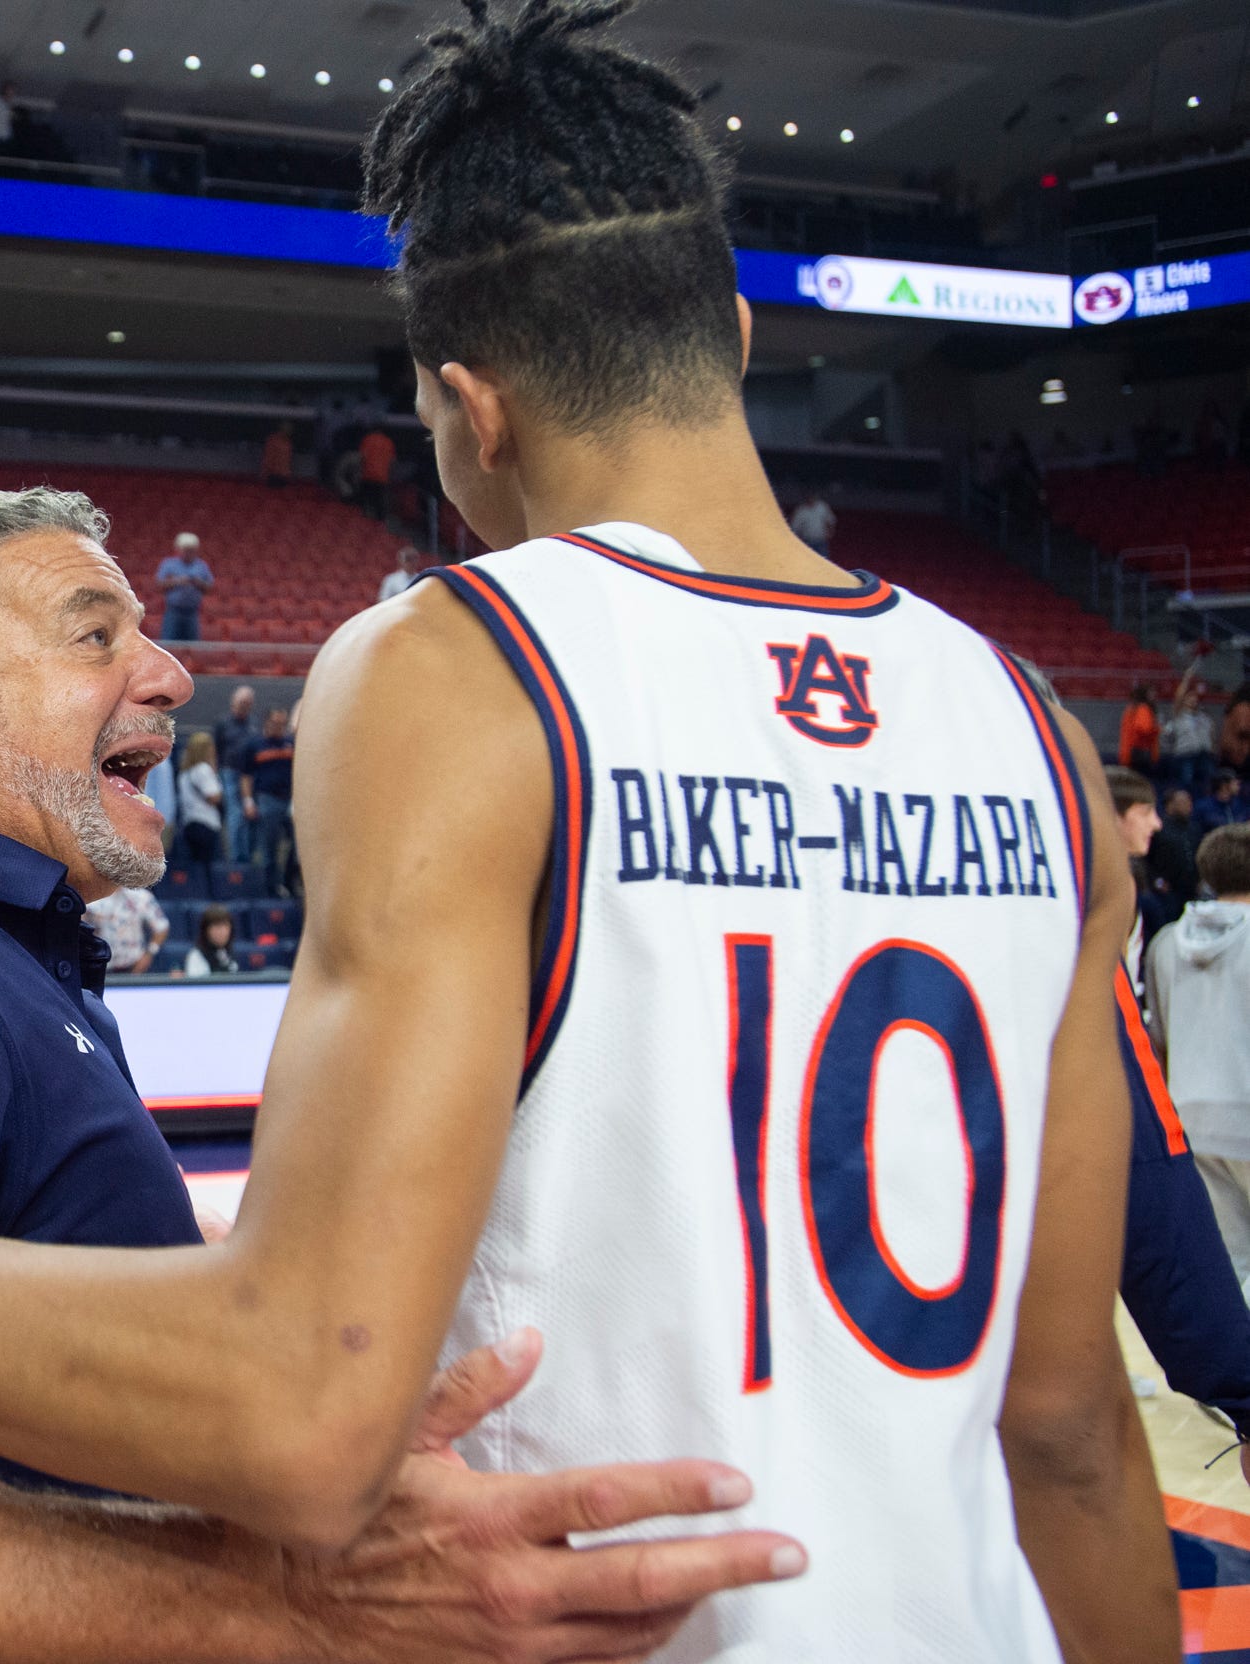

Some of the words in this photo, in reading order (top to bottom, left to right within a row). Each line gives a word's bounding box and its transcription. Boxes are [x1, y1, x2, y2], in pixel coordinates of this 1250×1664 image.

[1166, 260, 1211, 288] Chris
[933, 282, 1058, 317] REGIONS
[1135, 289, 1189, 317] Moore
[723, 932, 1007, 1395] 10
